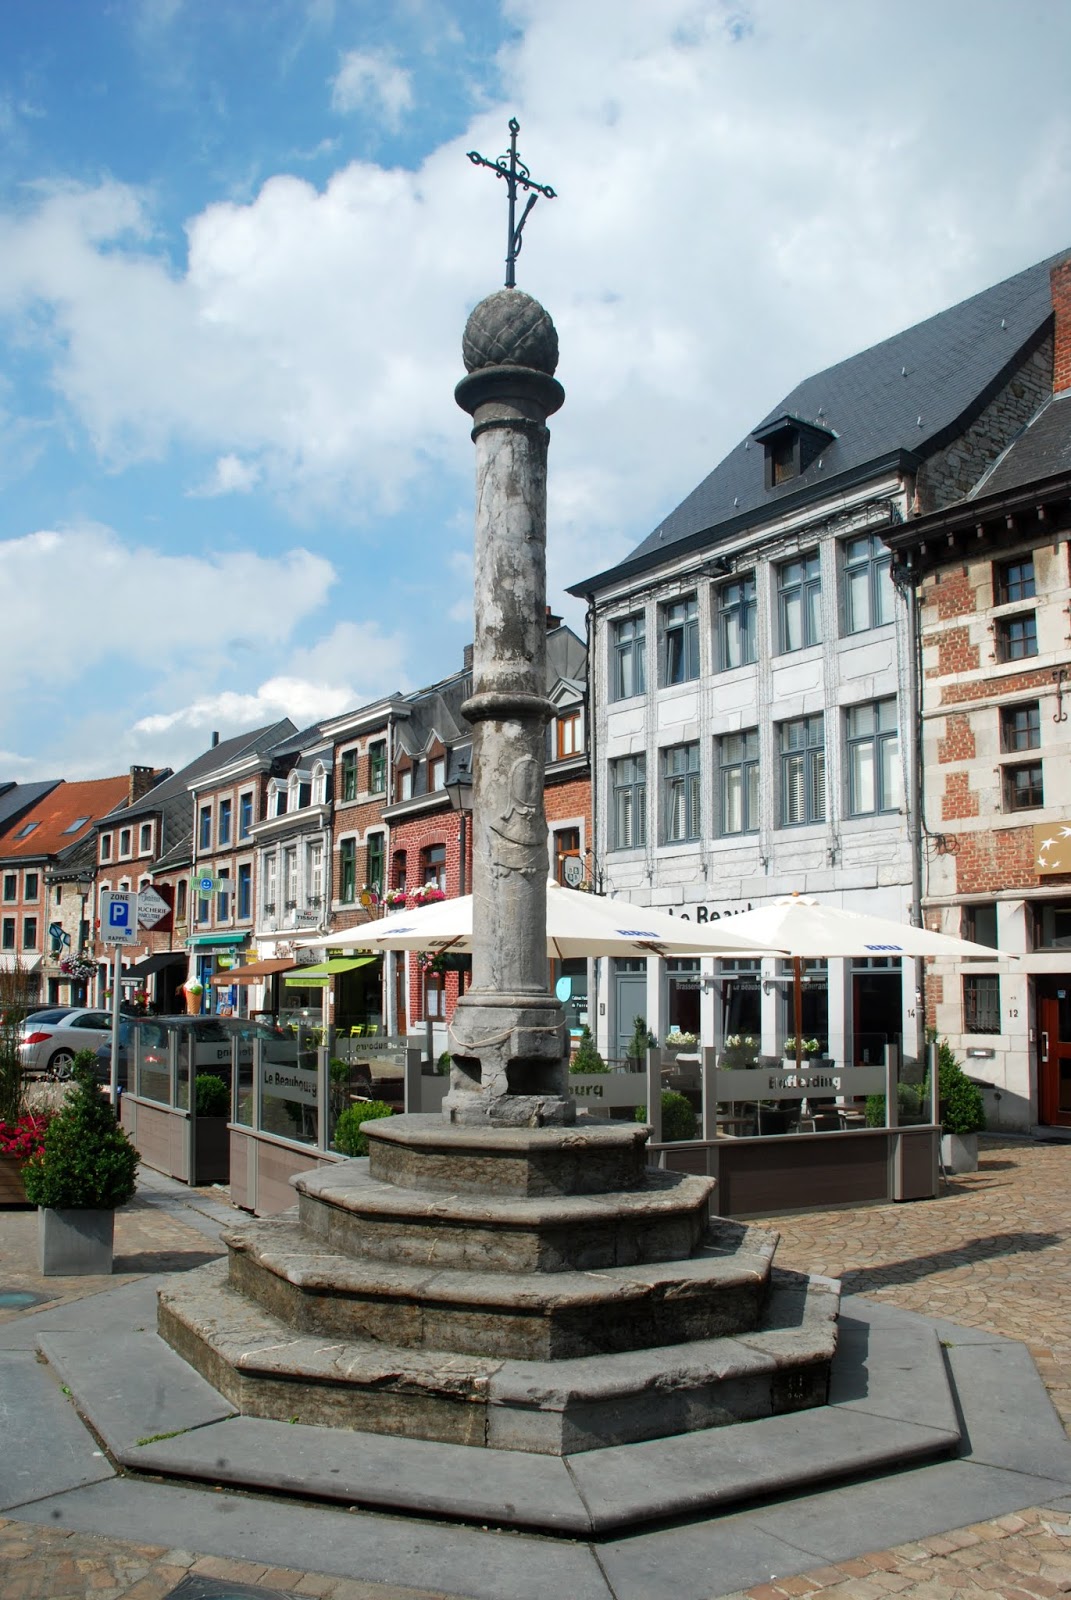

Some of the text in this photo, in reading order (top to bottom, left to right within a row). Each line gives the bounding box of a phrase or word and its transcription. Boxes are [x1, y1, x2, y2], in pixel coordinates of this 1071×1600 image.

[110, 893, 130, 901] ZONE
[113, 904, 125, 921] P
[907, 1009, 916, 1018] 14
[1009, 1009, 1019, 1018] 12
[264, 1071, 317, 1098] Le Beaubourg
